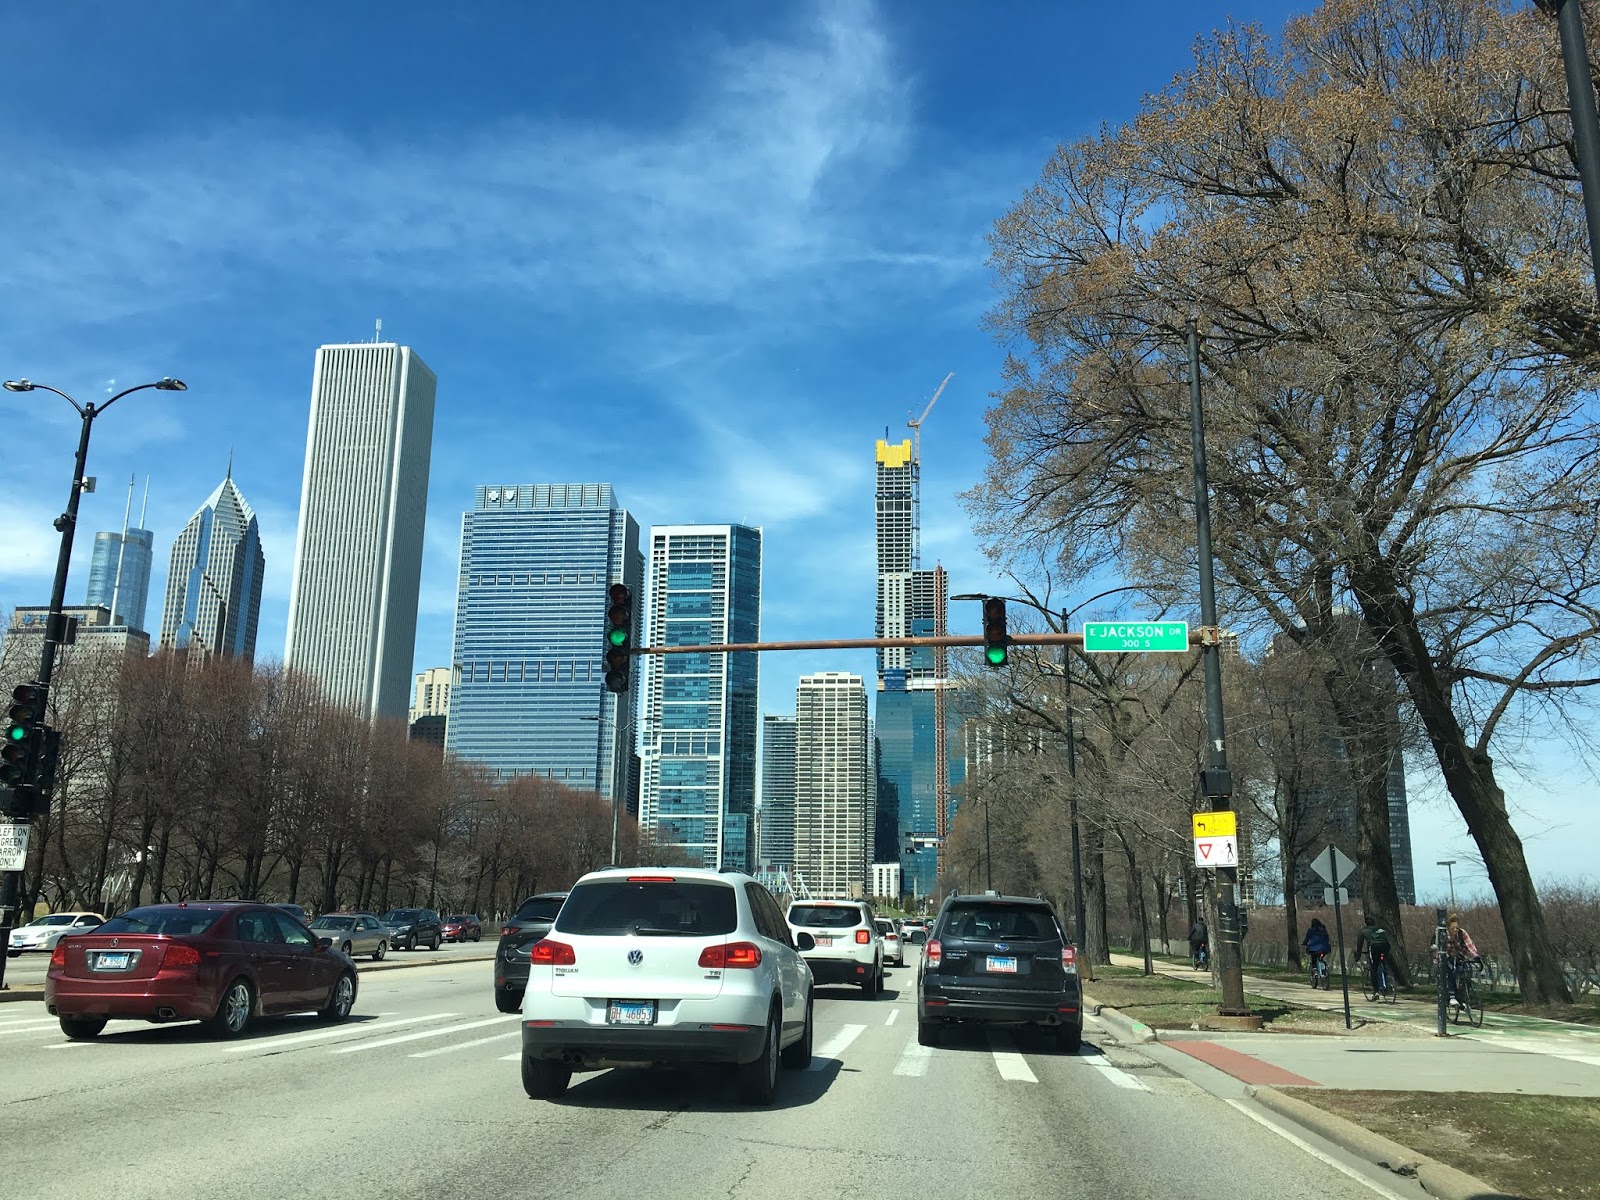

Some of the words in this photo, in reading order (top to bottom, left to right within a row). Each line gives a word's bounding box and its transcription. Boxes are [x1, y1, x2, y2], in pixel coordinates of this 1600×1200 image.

[1089, 628, 1096, 636] E
[1099, 626, 1164, 638] JACKSON
[1168, 627, 1181, 635] DR
[1122, 639, 1140, 648] 300
[1145, 640, 1151, 648] S
[17, 827, 28, 837] ON
[0, 837, 23, 847] GREEN
[0, 857, 17, 867] ONLY
[611, 1007, 622, 1019] BH
[626, 1008, 652, 1020] 46853
